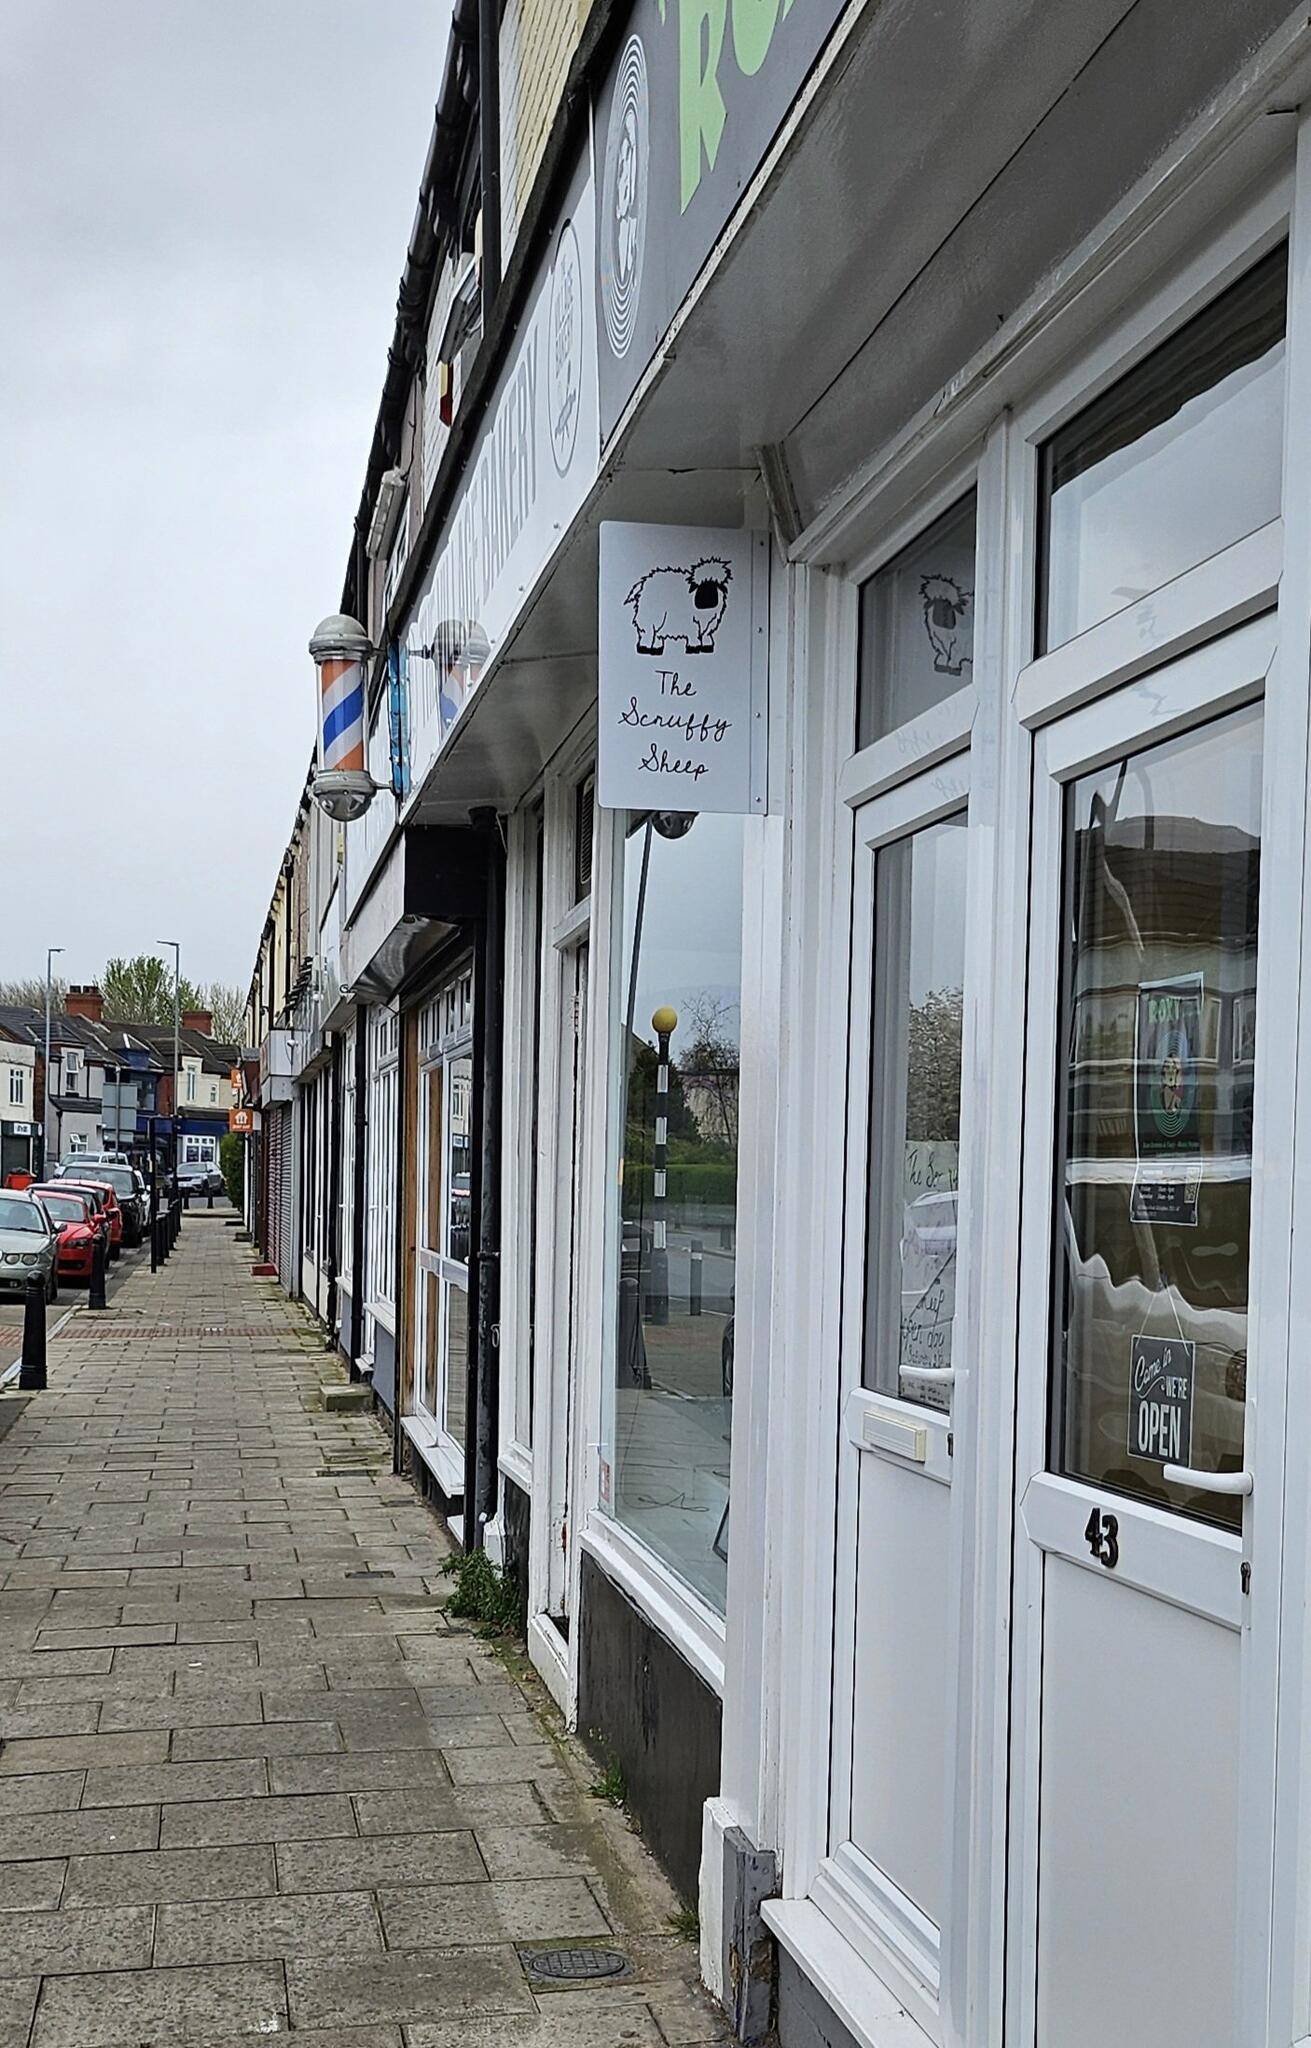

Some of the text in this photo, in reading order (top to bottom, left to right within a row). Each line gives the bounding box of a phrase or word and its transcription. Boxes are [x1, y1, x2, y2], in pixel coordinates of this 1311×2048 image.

[480, 325, 538, 607] BAKERY
[655, 669, 697, 697] The
[617, 697, 732, 742] Scruffy
[637, 743, 710, 783] Sheep
[1148, 997, 1182, 1024] ROXY
[1134, 1346, 1172, 1392] Come in
[1164, 1375, 1188, 1400] WE'RE
[1137, 1400, 1182, 1460] OPEN
[1084, 1507, 1120, 1569] 43
